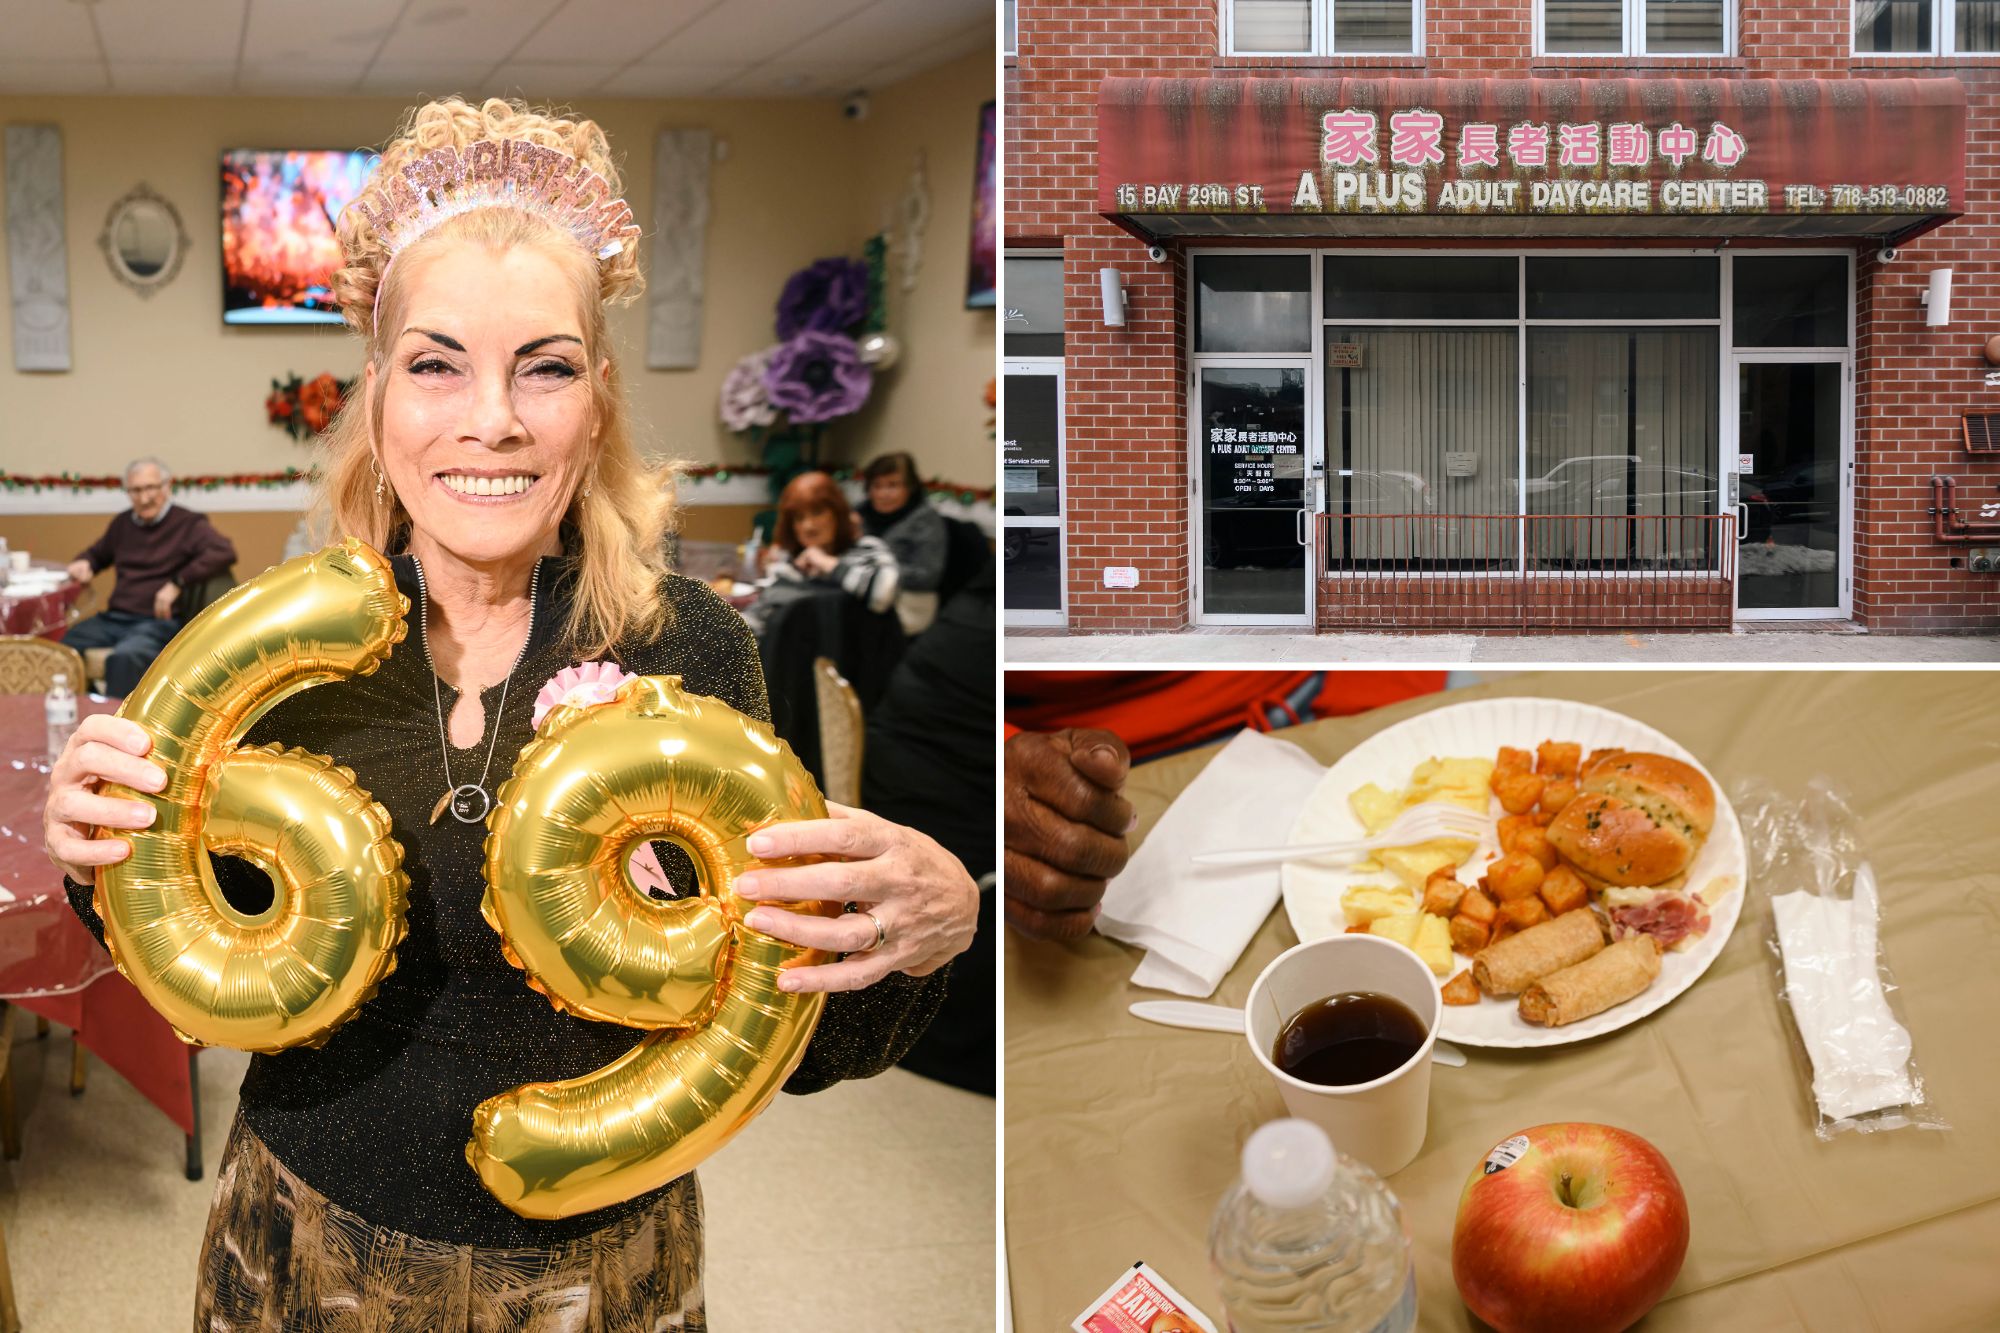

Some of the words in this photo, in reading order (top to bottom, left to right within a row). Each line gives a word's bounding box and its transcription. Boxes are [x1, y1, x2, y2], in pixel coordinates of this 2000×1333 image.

[1322, 109, 1746, 168] 家家長者活動中心
[473, 138, 642, 241] BIRTHDAY
[1117, 185, 1135, 205] 15
[1144, 185, 1180, 205] BAY
[1188, 185, 1228, 205] 29th
[1236, 185, 1263, 205] ST.
[1295, 172, 1321, 207] A
[1337, 171, 1424, 207] PLUS
[1439, 181, 1518, 206] ADULT
[1532, 182, 1648, 207] DAYCARE
[1662, 182, 1765, 207] CENTER
[1785, 186, 1823, 206] TEL:
[1832, 186, 1947, 207] 718-513-0882
[1211, 444, 1215, 453] A
[1217, 444, 1232, 454] PLUS
[1234, 444, 1250, 454] ADULT
[1276, 445, 1297, 454] CENTER
[1116, 1287, 1158, 1326] JAM
[1135, 1277, 1177, 1314] STRAWBERRY
